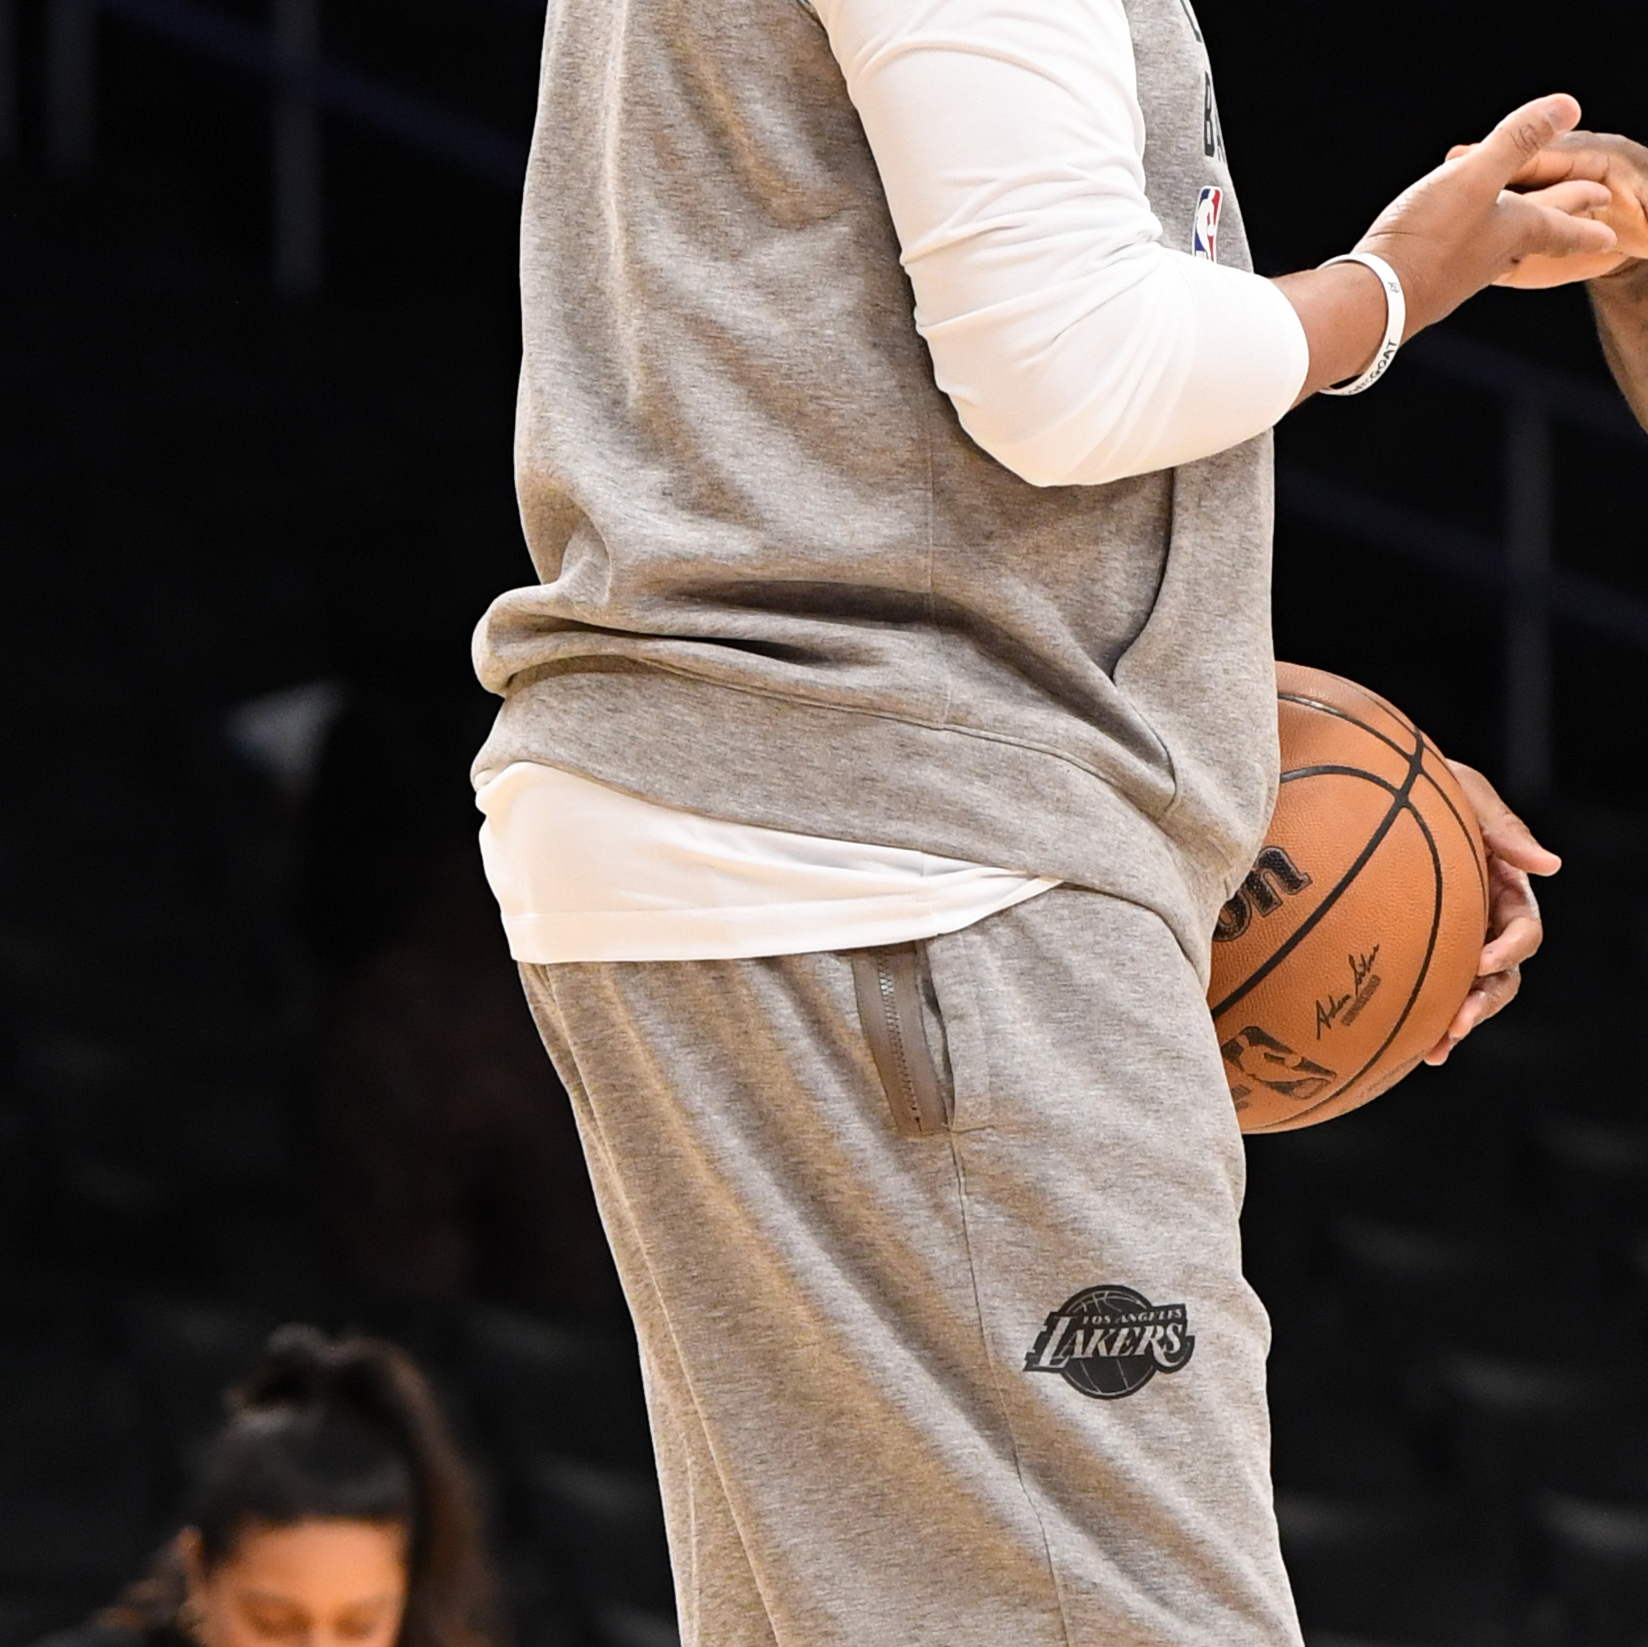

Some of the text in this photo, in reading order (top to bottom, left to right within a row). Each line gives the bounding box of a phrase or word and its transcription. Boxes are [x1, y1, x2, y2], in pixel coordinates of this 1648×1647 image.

[1082, 1308, 1183, 1325] LOS ANGELES
[1032, 1315, 1185, 1369] LAKERS
